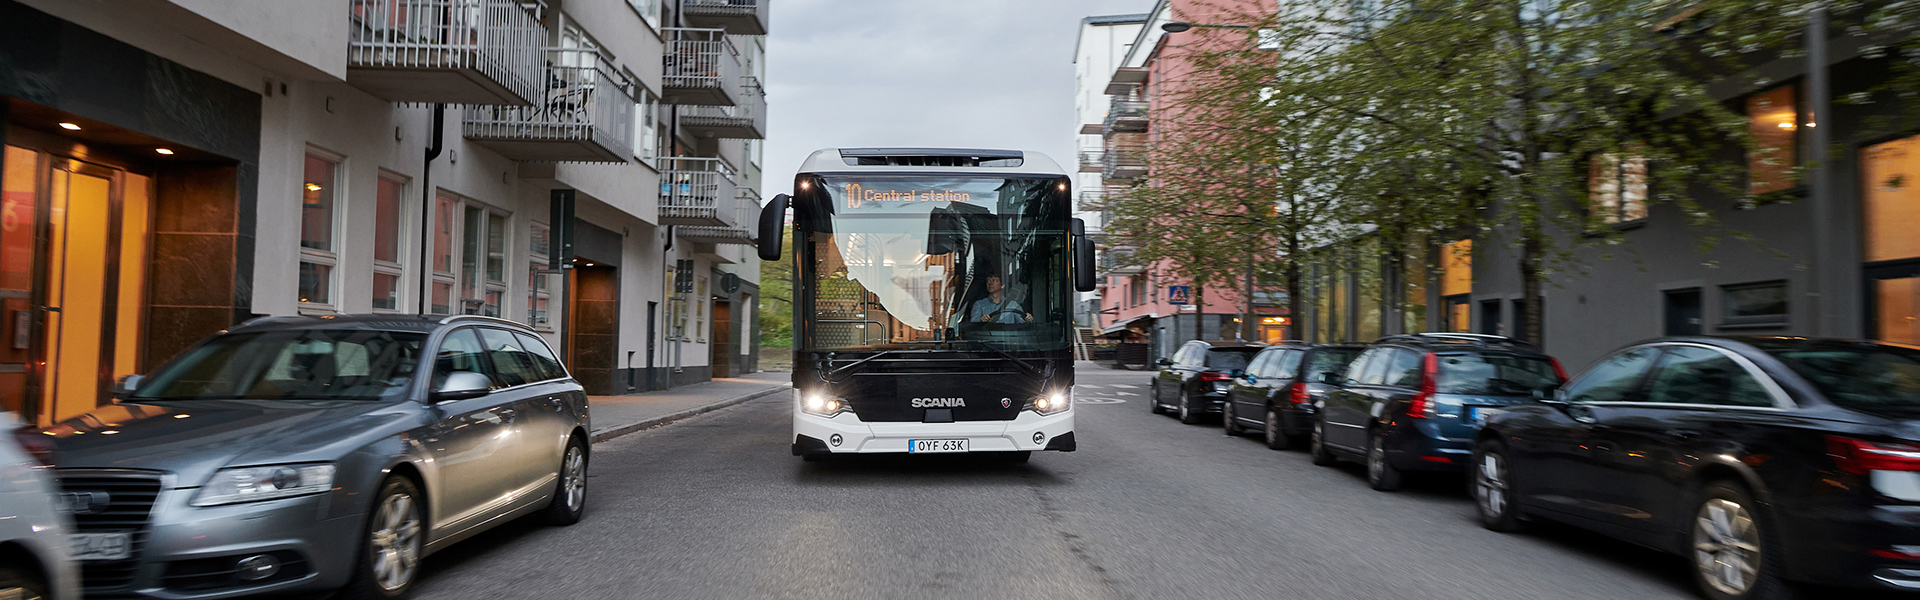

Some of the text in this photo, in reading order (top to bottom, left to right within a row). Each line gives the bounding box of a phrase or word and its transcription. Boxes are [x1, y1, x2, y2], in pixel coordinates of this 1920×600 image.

[845, 183, 970, 208] 10 Central station
[911, 397, 966, 408] SCANIA
[918, 441, 964, 451] OYF 63K
